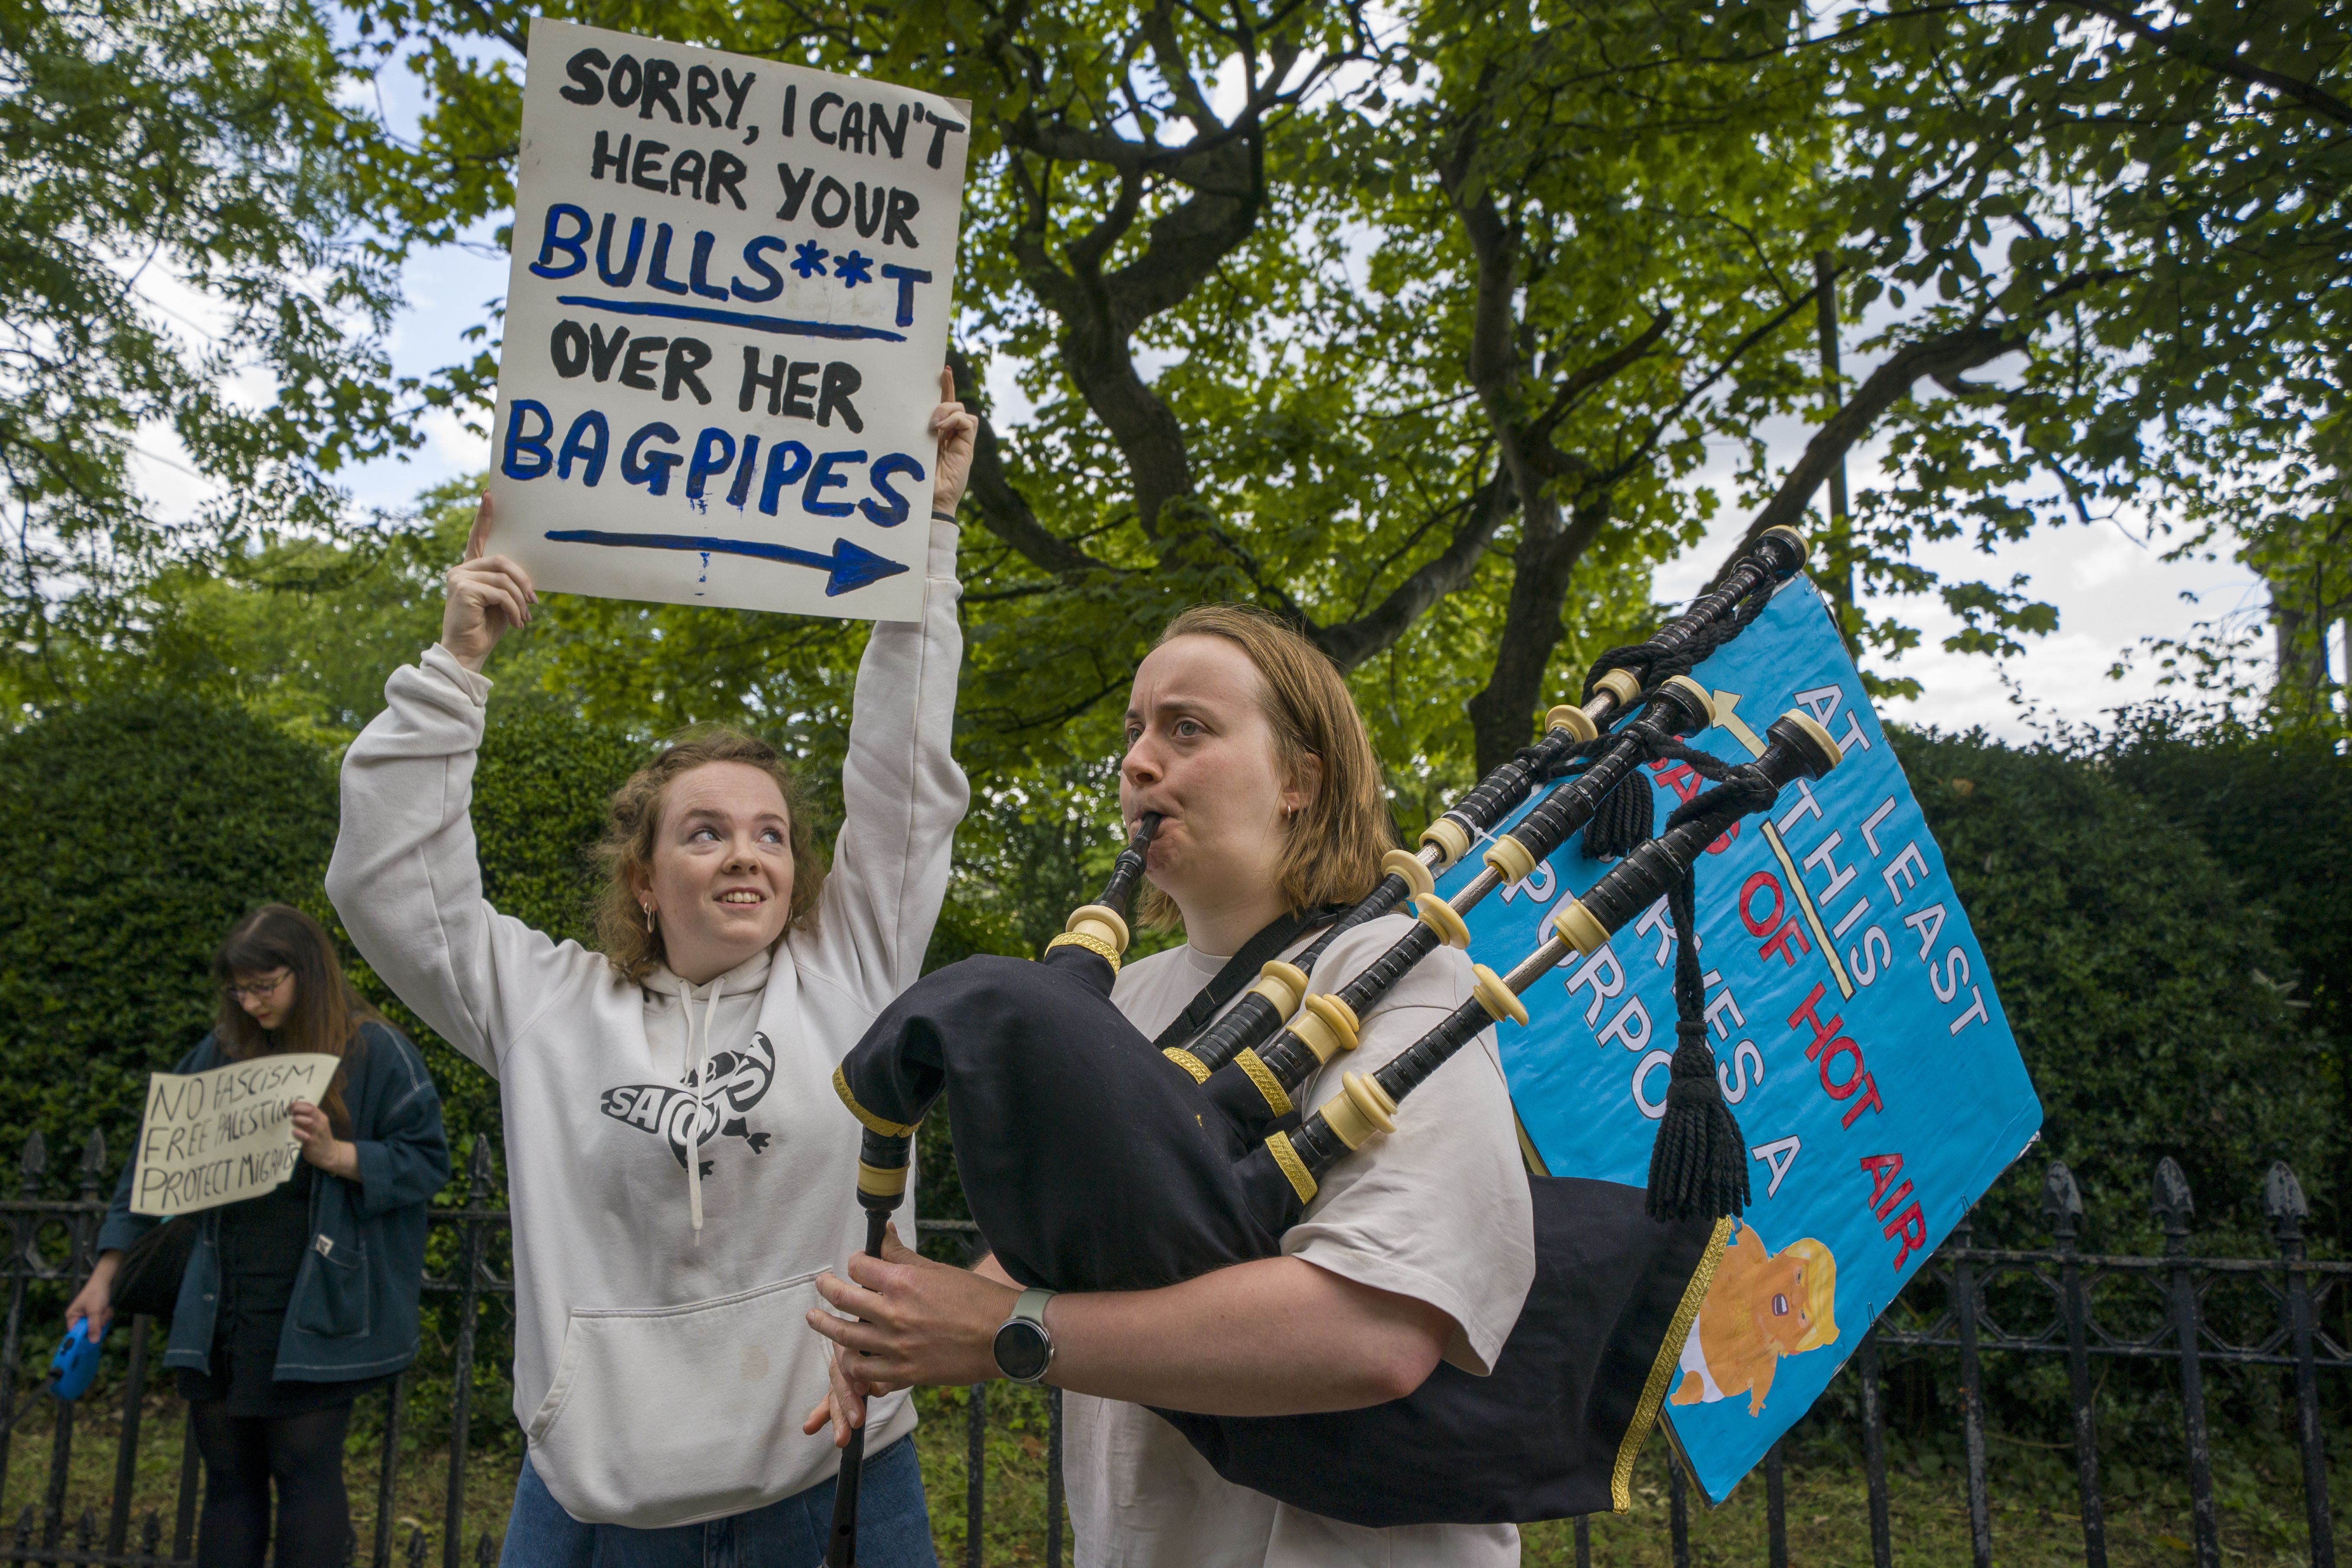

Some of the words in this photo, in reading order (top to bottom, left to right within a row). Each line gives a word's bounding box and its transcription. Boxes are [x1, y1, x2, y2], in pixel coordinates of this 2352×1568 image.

[559, 48, 759, 146] SORRY,
[782, 84, 797, 137] I
[809, 92, 965, 169] CAN'T
[590, 130, 747, 211] HEAR
[776, 163, 920, 249] YOUR
[551, 319, 713, 405] OVER
[739, 345, 863, 434] HER
[501, 398, 925, 527] BAGPIPES
[1776, 779, 1892, 988] THIS
[1792, 683, 1872, 756] AT
[1860, 795, 1990, 1038] LEAST
[151, 1077, 205, 1121] NO
[1738, 870, 1812, 968] OF
[1787, 981, 1884, 1130] HOT
[1859, 1153, 1927, 1274] AIR
[140, 1158, 233, 1209] PROTECT
[145, 1118, 212, 1164] FREE
[1750, 1134, 1802, 1201] A
